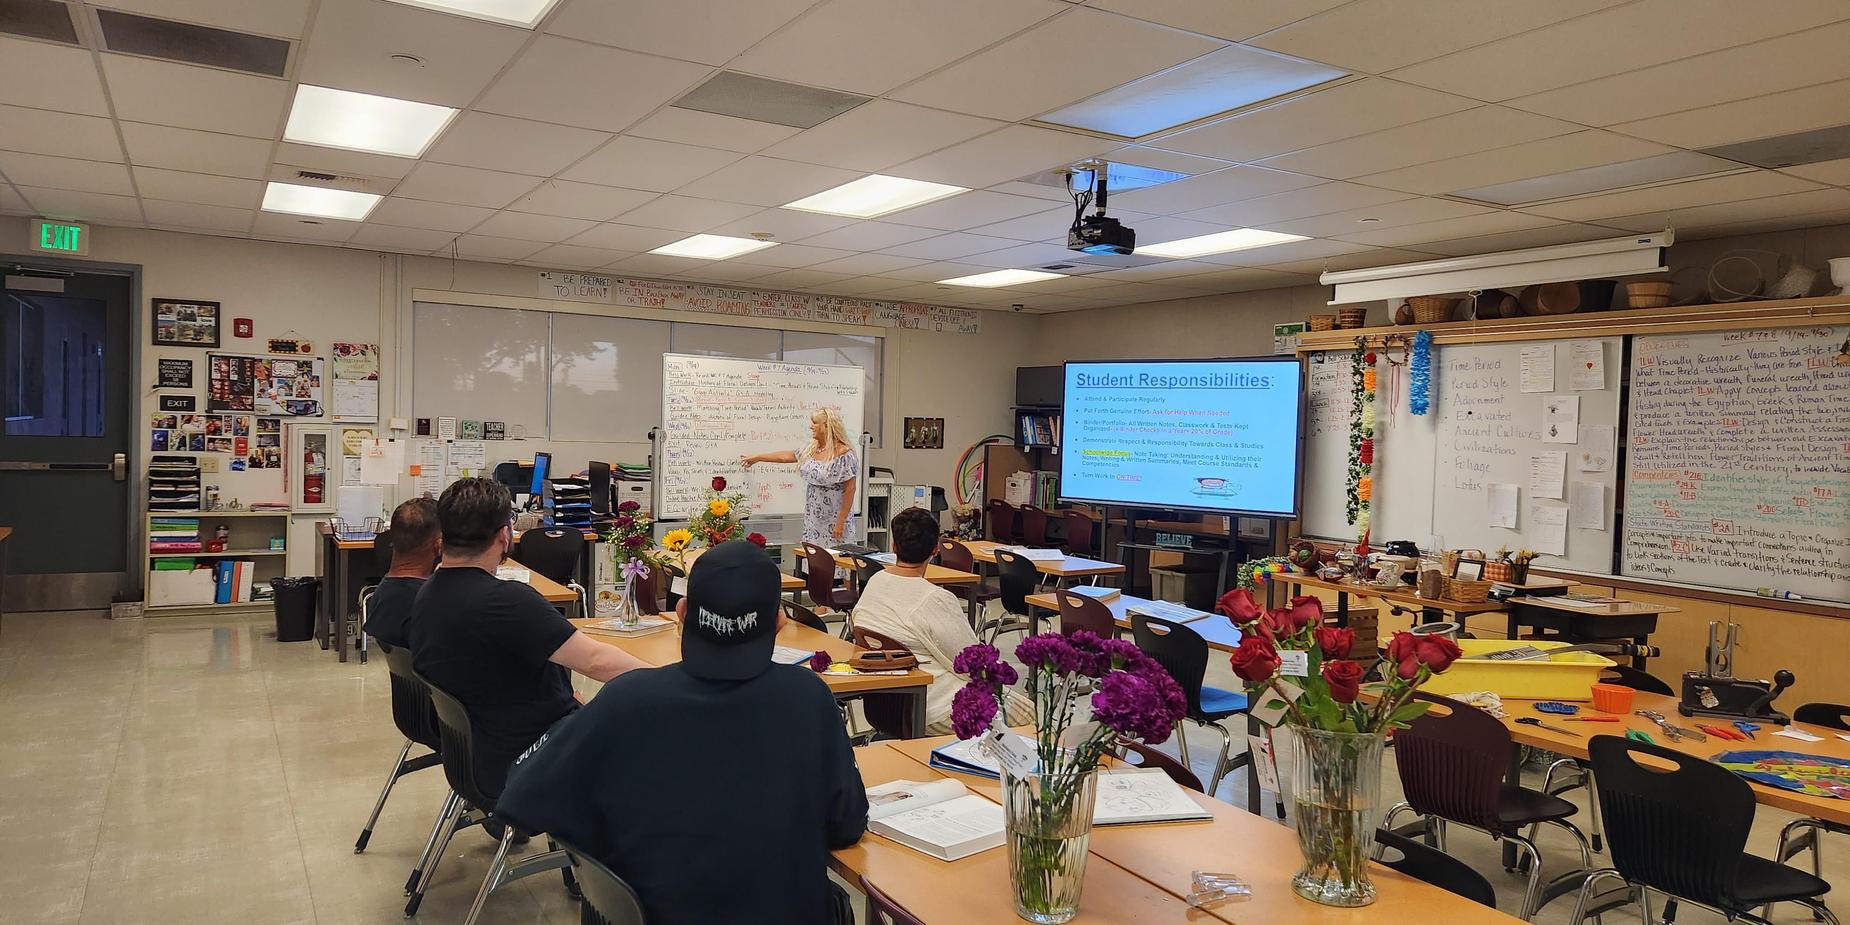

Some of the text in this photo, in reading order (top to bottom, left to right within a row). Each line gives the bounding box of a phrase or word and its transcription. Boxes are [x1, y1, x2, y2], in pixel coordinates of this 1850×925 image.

[41, 223, 81, 251] EXIT
[554, 286, 570, 297] TO
[1448, 358, 1472, 371] Time
[1656, 354, 1693, 368] Visually
[1747, 348, 1778, 360] Various
[1076, 372, 1275, 389] Student Responsibilities:
[1482, 376, 1509, 392] Style
[1716, 386, 1741, 400] Apply
[1786, 383, 1819, 392] learned
[1453, 393, 1504, 406] Adornment
[1760, 407, 1796, 419] relating
[1454, 440, 1517, 455] Civilizations
[1156, 532, 1193, 546] BELIEVE
[1736, 526, 1777, 540] Introduce
[1785, 531, 1808, 545] Topic
